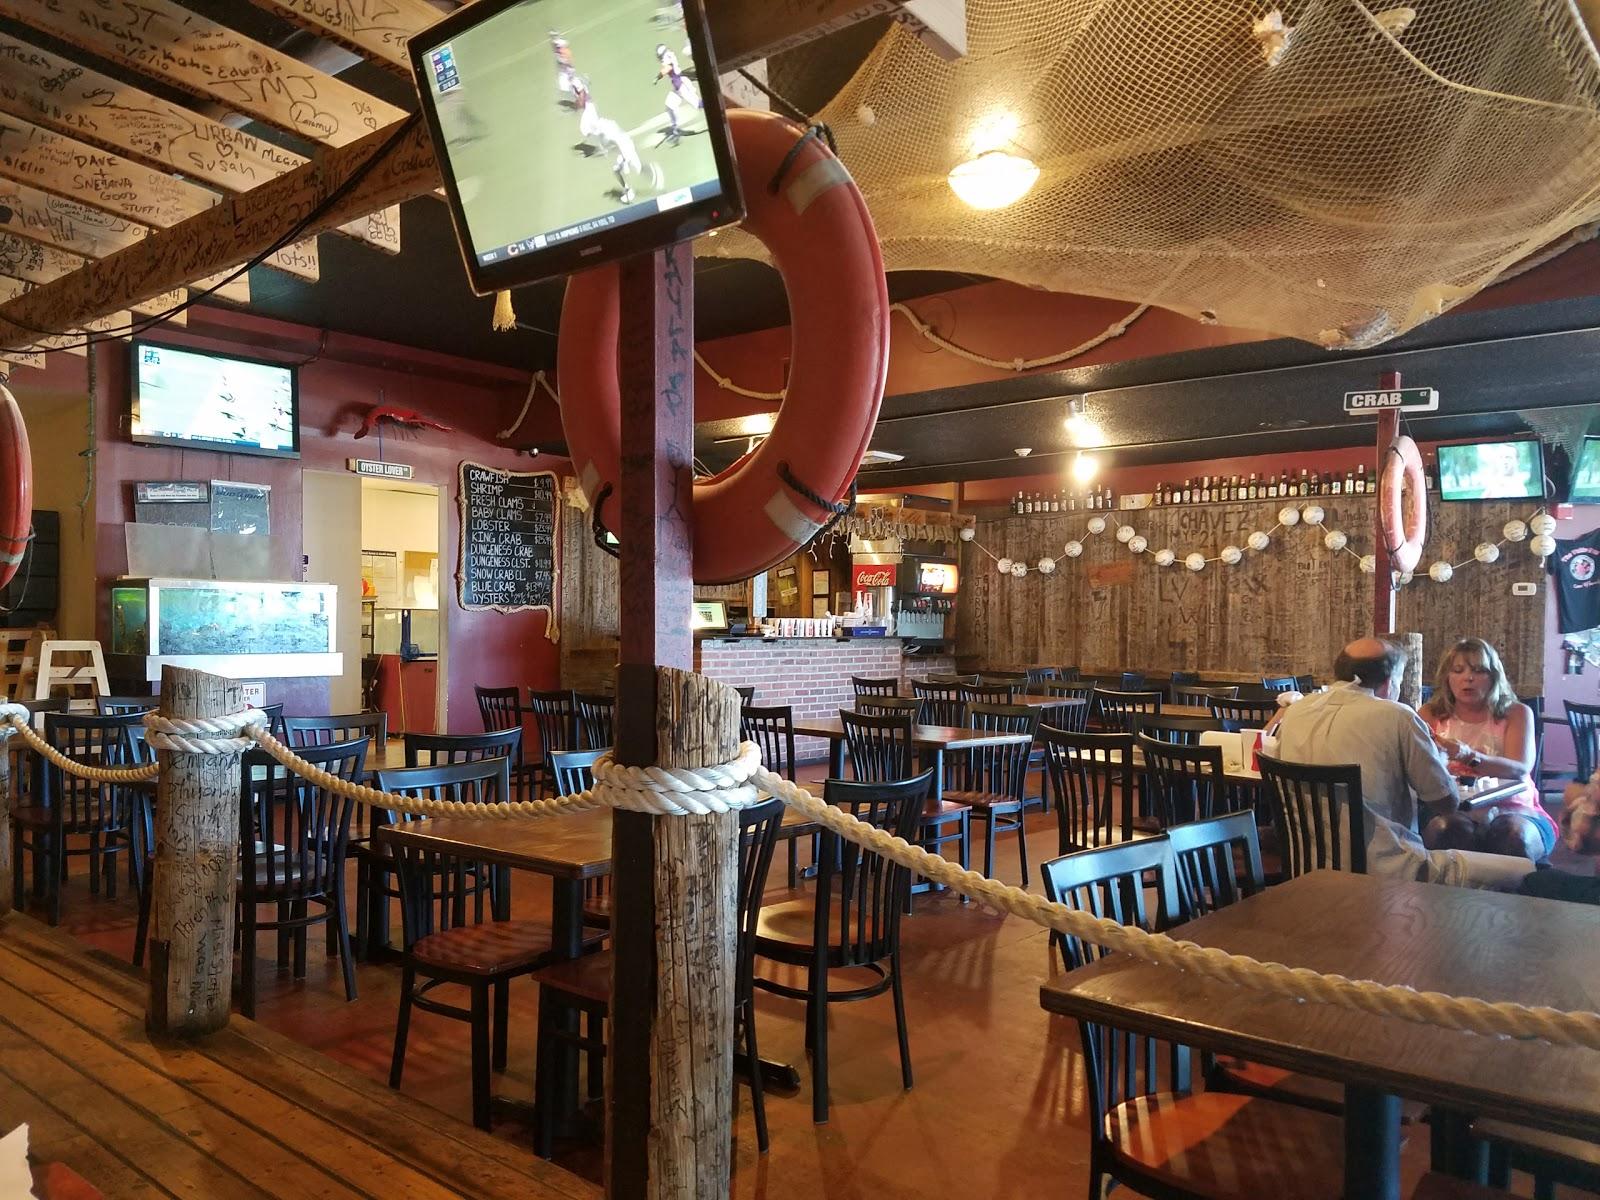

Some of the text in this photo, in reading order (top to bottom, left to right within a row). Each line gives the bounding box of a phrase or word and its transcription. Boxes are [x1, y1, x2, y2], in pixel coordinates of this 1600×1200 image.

[194, 123, 258, 151] URBAN
[74, 155, 120, 168] DAVE
[100, 191, 137, 201] GOOD
[1352, 392, 1402, 407] CRAB
[361, 462, 383, 474] OYSTER
[385, 464, 404, 476] LOVER
[470, 470, 509, 484] CRAWFISH
[470, 482, 504, 496] SHRIMP
[471, 494, 525, 510] FRESH CLAMS
[471, 506, 523, 521] BABY CLAMS
[471, 519, 511, 532] LOBSTER
[1180, 510, 1250, 534] CHAVEZ
[471, 531, 522, 546] KING CRAB
[470, 543, 534, 558] DUNGENESS CRAB
[470, 556, 511, 568] DUNGENESS
[470, 568, 493, 580] SNOW
[494, 569, 514, 581] CRAB
[471, 581, 493, 592] BLUE
[494, 581, 516, 593] CRAB
[472, 593, 510, 605] OYSTERS
